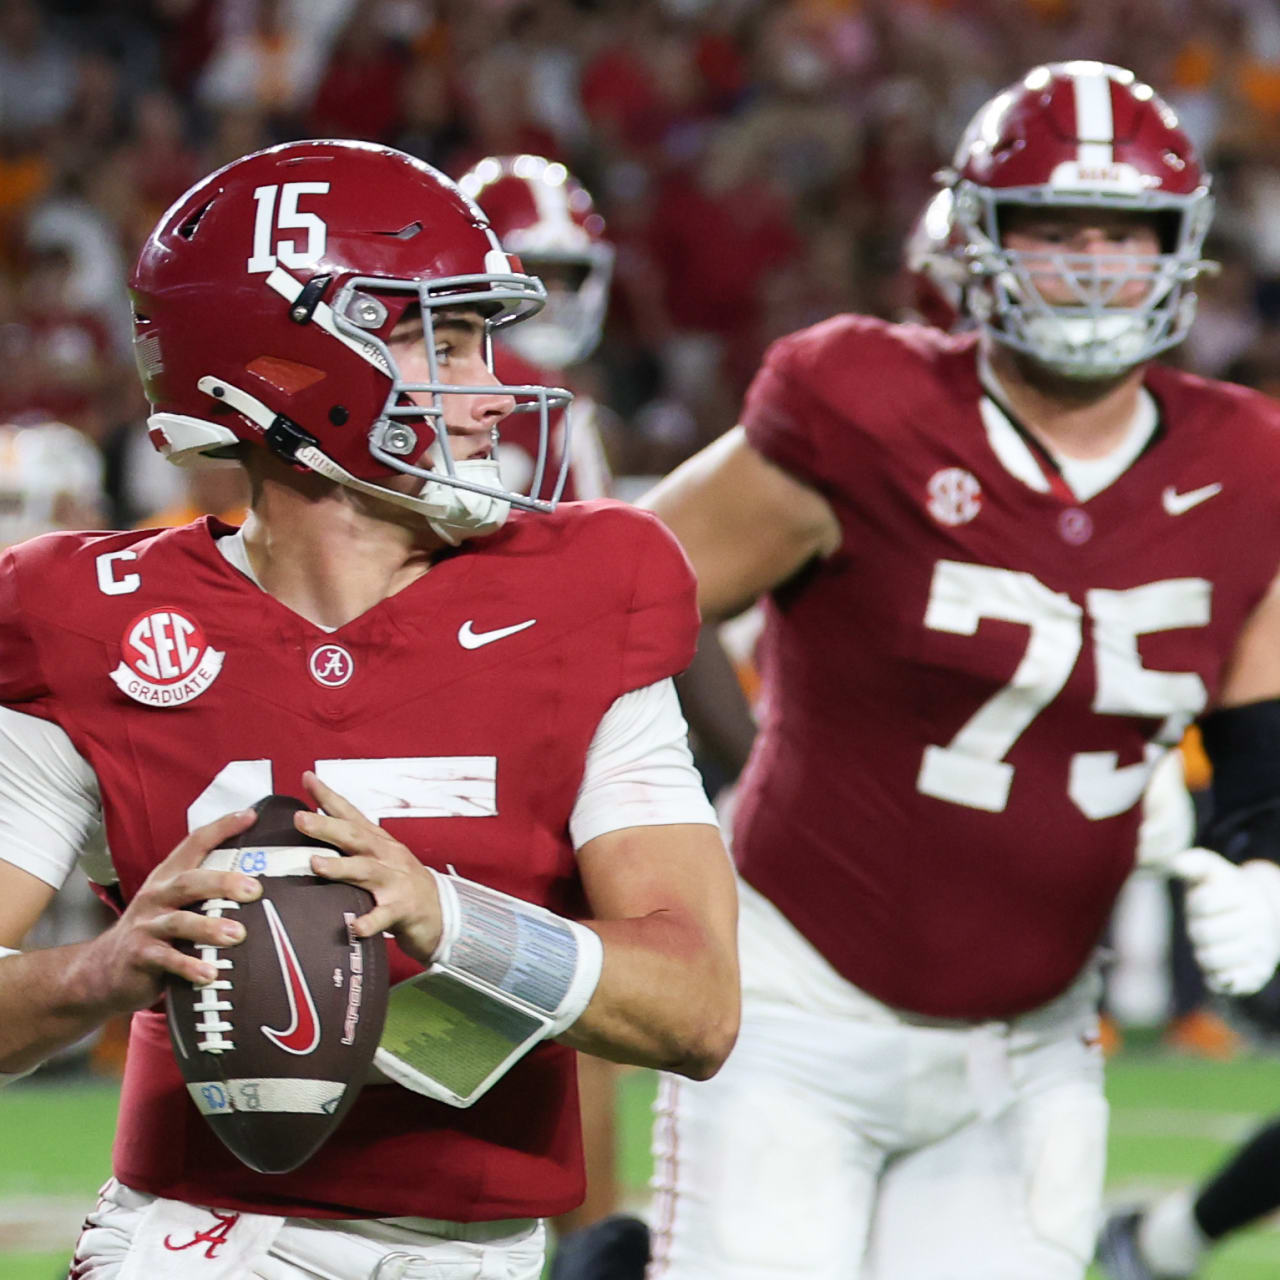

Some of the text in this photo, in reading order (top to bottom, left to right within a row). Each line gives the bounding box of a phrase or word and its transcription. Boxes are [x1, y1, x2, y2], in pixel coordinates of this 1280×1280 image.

[246, 182, 331, 274] 15
[96, 550, 142, 596] C
[128, 612, 200, 681] SEC
[128, 668, 213, 704] GRADUATE
[917, 559, 1213, 821] 75
